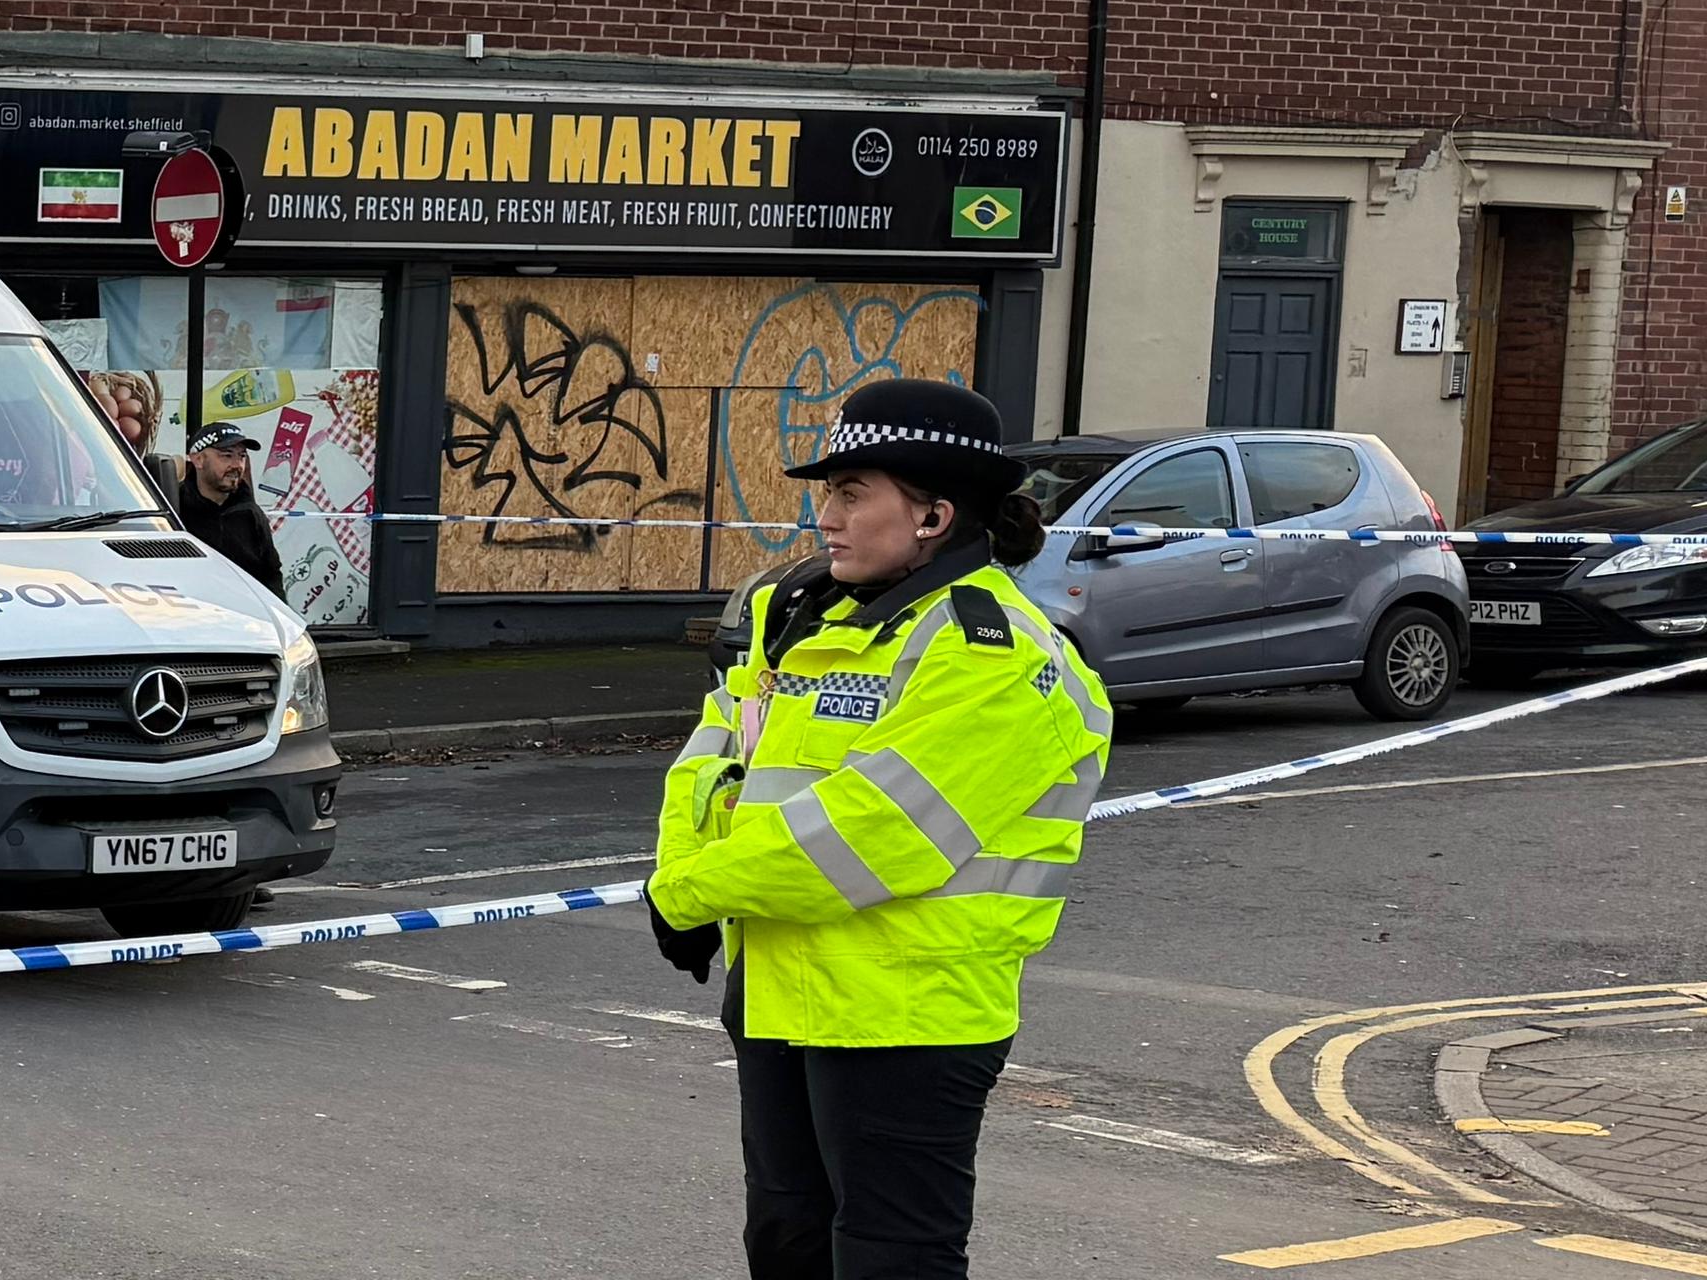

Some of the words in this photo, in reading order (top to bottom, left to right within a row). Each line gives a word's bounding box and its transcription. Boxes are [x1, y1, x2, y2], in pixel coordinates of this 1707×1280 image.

[28, 116, 183, 131] abadan.market.sheffield
[262, 106, 533, 182] ABADAN
[548, 114, 801, 187] MARKET
[918, 136, 952, 156] 0114
[959, 137, 990, 157] 250
[996, 138, 1038, 158] 8989
[268, 194, 348, 222] DRINKS,
[355, 196, 414, 221] FRESH
[422, 198, 488, 225] BREAD,
[497, 199, 555, 224] FRESH
[562, 200, 615, 227] MEAT,
[623, 201, 680, 226] FRESH
[688, 202, 742, 230] FRUIT,
[749, 203, 893, 230] CONFECTIONERY
[1252, 218, 1308, 229] CENTURY
[1259, 232, 1299, 243] HOUSE
[1470, 603, 1495, 619] P12
[1498, 603, 1530, 620] PHZ
[819, 695, 874, 718] POLICE
[107, 837, 174, 866] YN67
[182, 834, 227, 863] CHG
